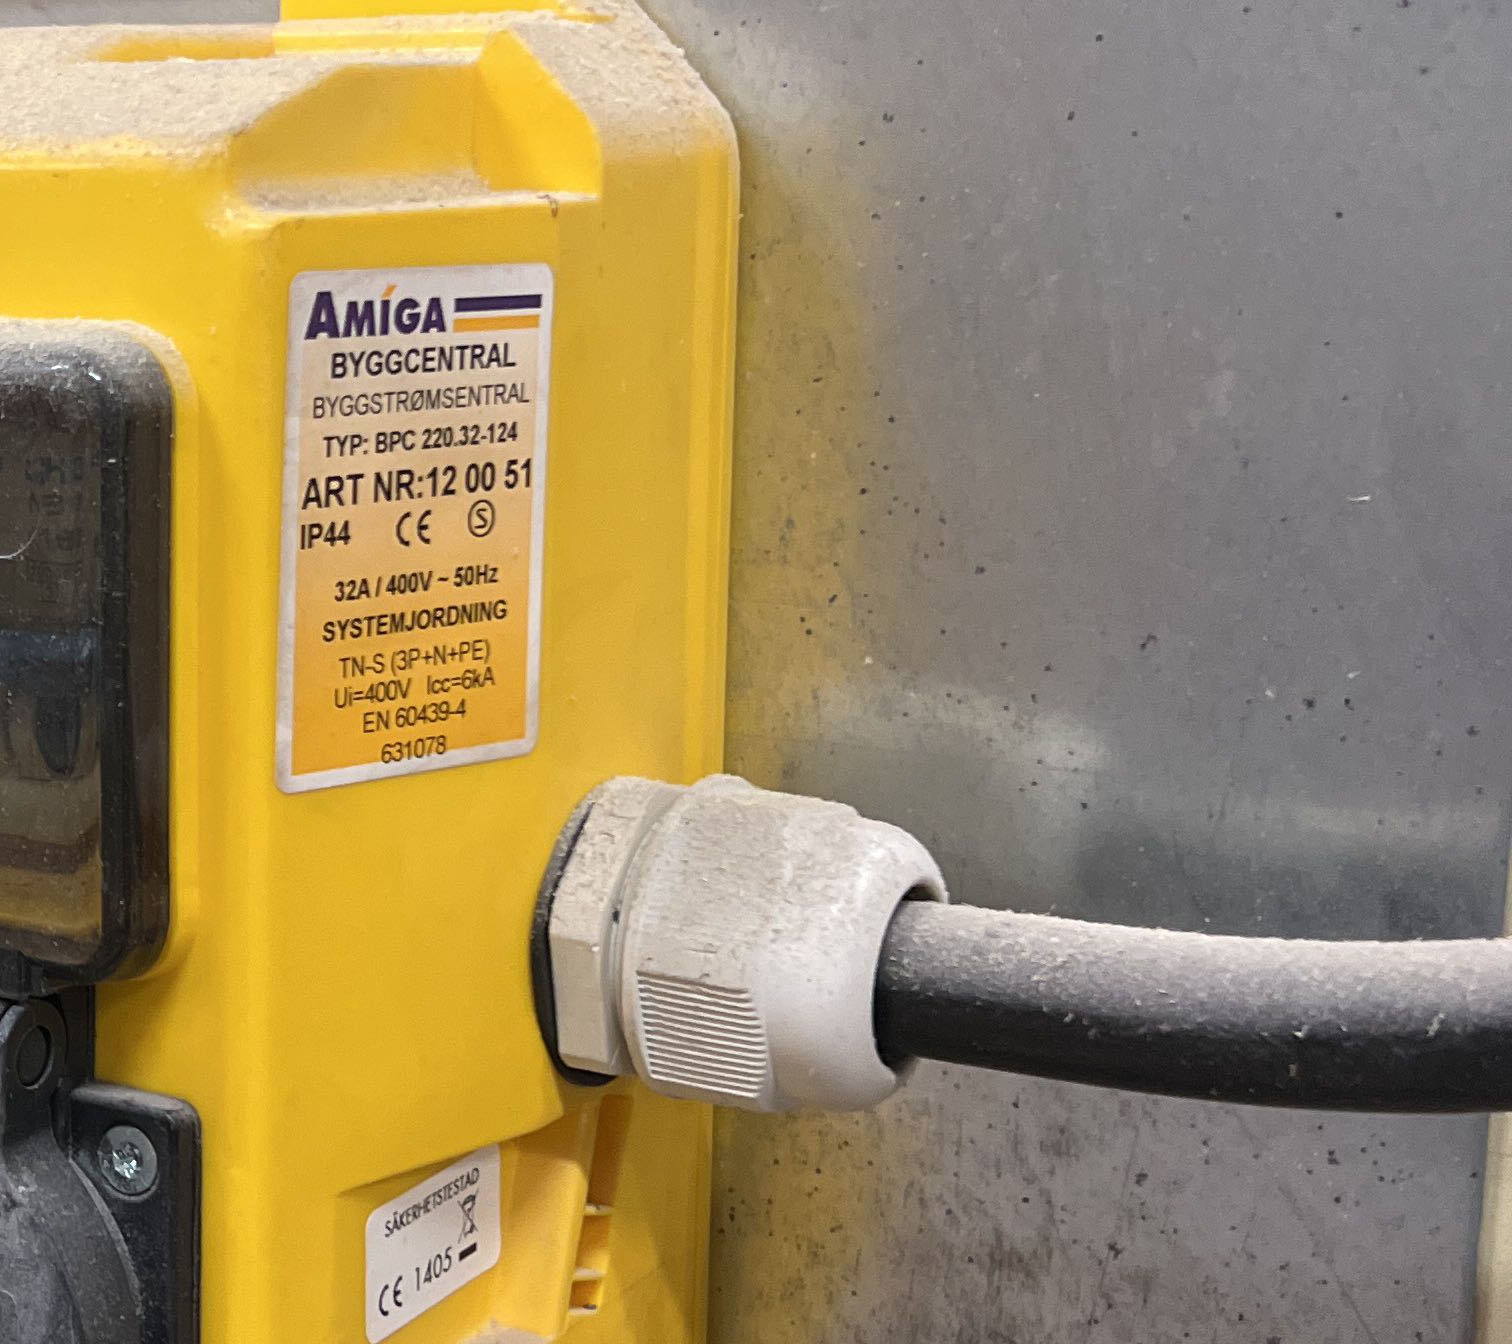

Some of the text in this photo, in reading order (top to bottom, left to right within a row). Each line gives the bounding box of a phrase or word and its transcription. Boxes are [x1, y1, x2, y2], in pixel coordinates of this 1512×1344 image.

[331, 342, 516, 379] BYGGCENTRAL
[312, 382, 530, 419] BYGGSTRØMSENTRAL
[323, 421, 518, 457] TYP: BPC 220.32-124
[301, 473, 364, 510] ART
[465, 462, 496, 493] 00
[504, 458, 532, 489] 51
[300, 520, 351, 550] IP44
[334, 578, 370, 602] 32A
[386, 570, 433, 595] 400V
[453, 564, 498, 587] 50Hz
[322, 599, 507, 642] SYSTEMJORDNING
[339, 639, 490, 678] TN-S (3P+N+PE)
[334, 678, 411, 708] Ui=400V
[363, 698, 466, 733] EN 60439-4
[381, 735, 446, 763] 631078
[415, 1247, 452, 1291] 1405
